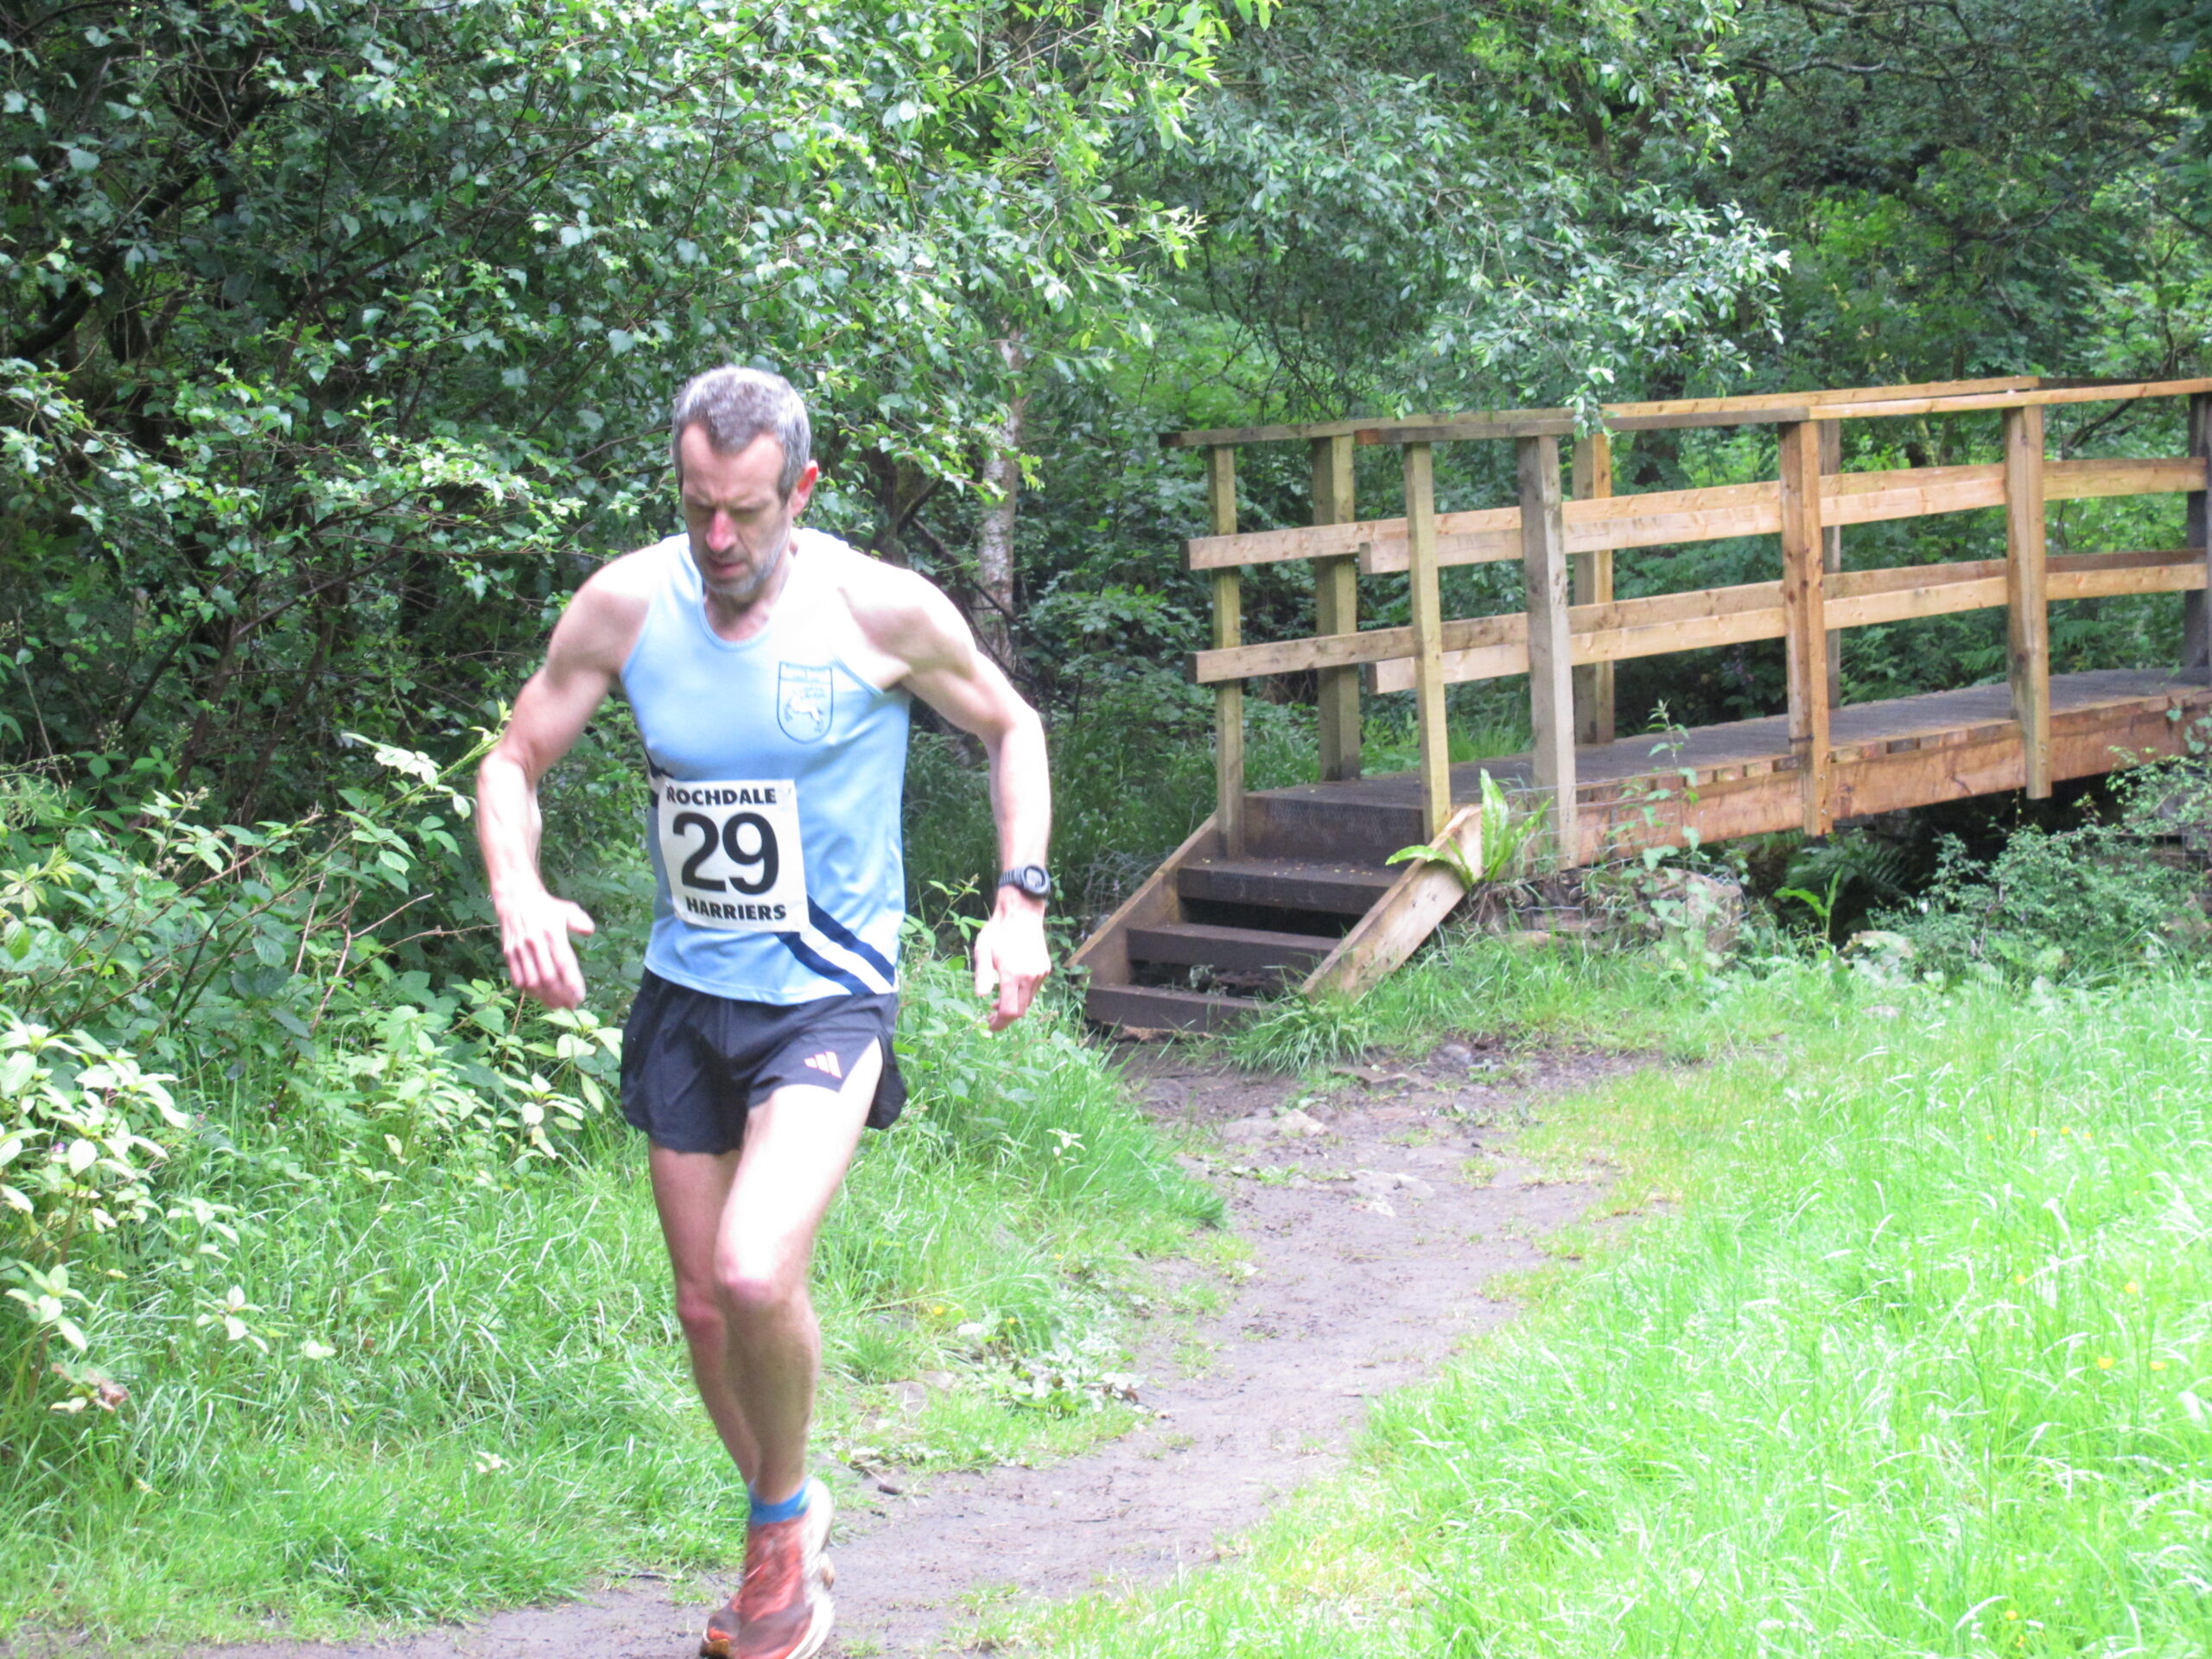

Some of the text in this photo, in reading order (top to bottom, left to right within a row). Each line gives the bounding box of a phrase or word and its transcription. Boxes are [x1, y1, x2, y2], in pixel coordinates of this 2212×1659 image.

[666, 785, 777, 805] ROCHDALE
[672, 811, 779, 895] 29
[685, 895, 787, 920] HARRIERS
